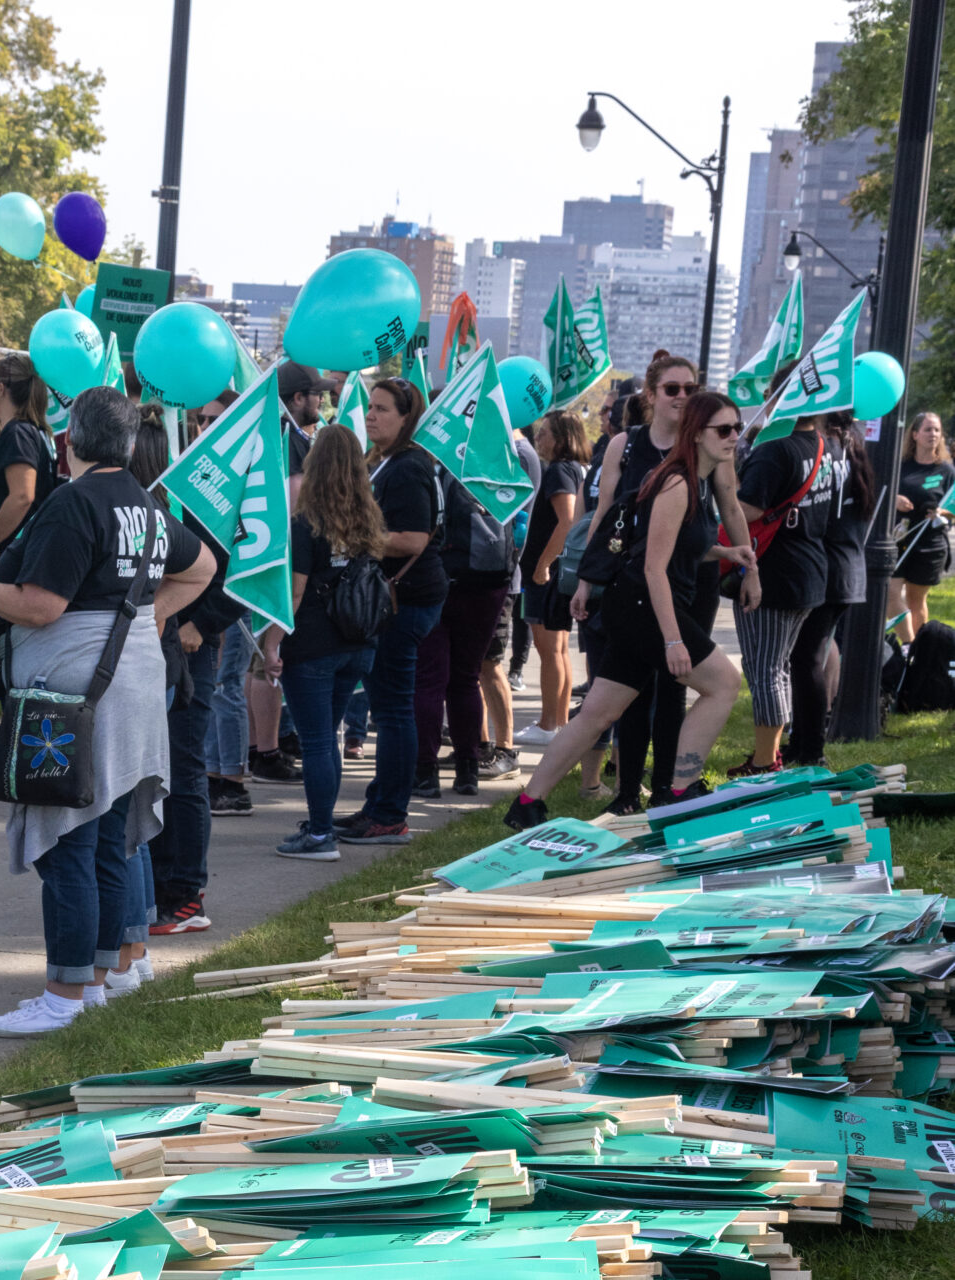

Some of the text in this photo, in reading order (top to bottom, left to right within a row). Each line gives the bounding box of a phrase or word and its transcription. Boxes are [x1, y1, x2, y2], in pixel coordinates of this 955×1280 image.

[106, 312, 114, 321] DE
[804, 371, 820, 393] VOIX
[194, 453, 230, 487] FRONT
[187, 470, 234, 516] COMMUN
[26, 711, 40, 720] La
[25, 769, 39, 780] est
[513, 827, 599, 863] NOUS
